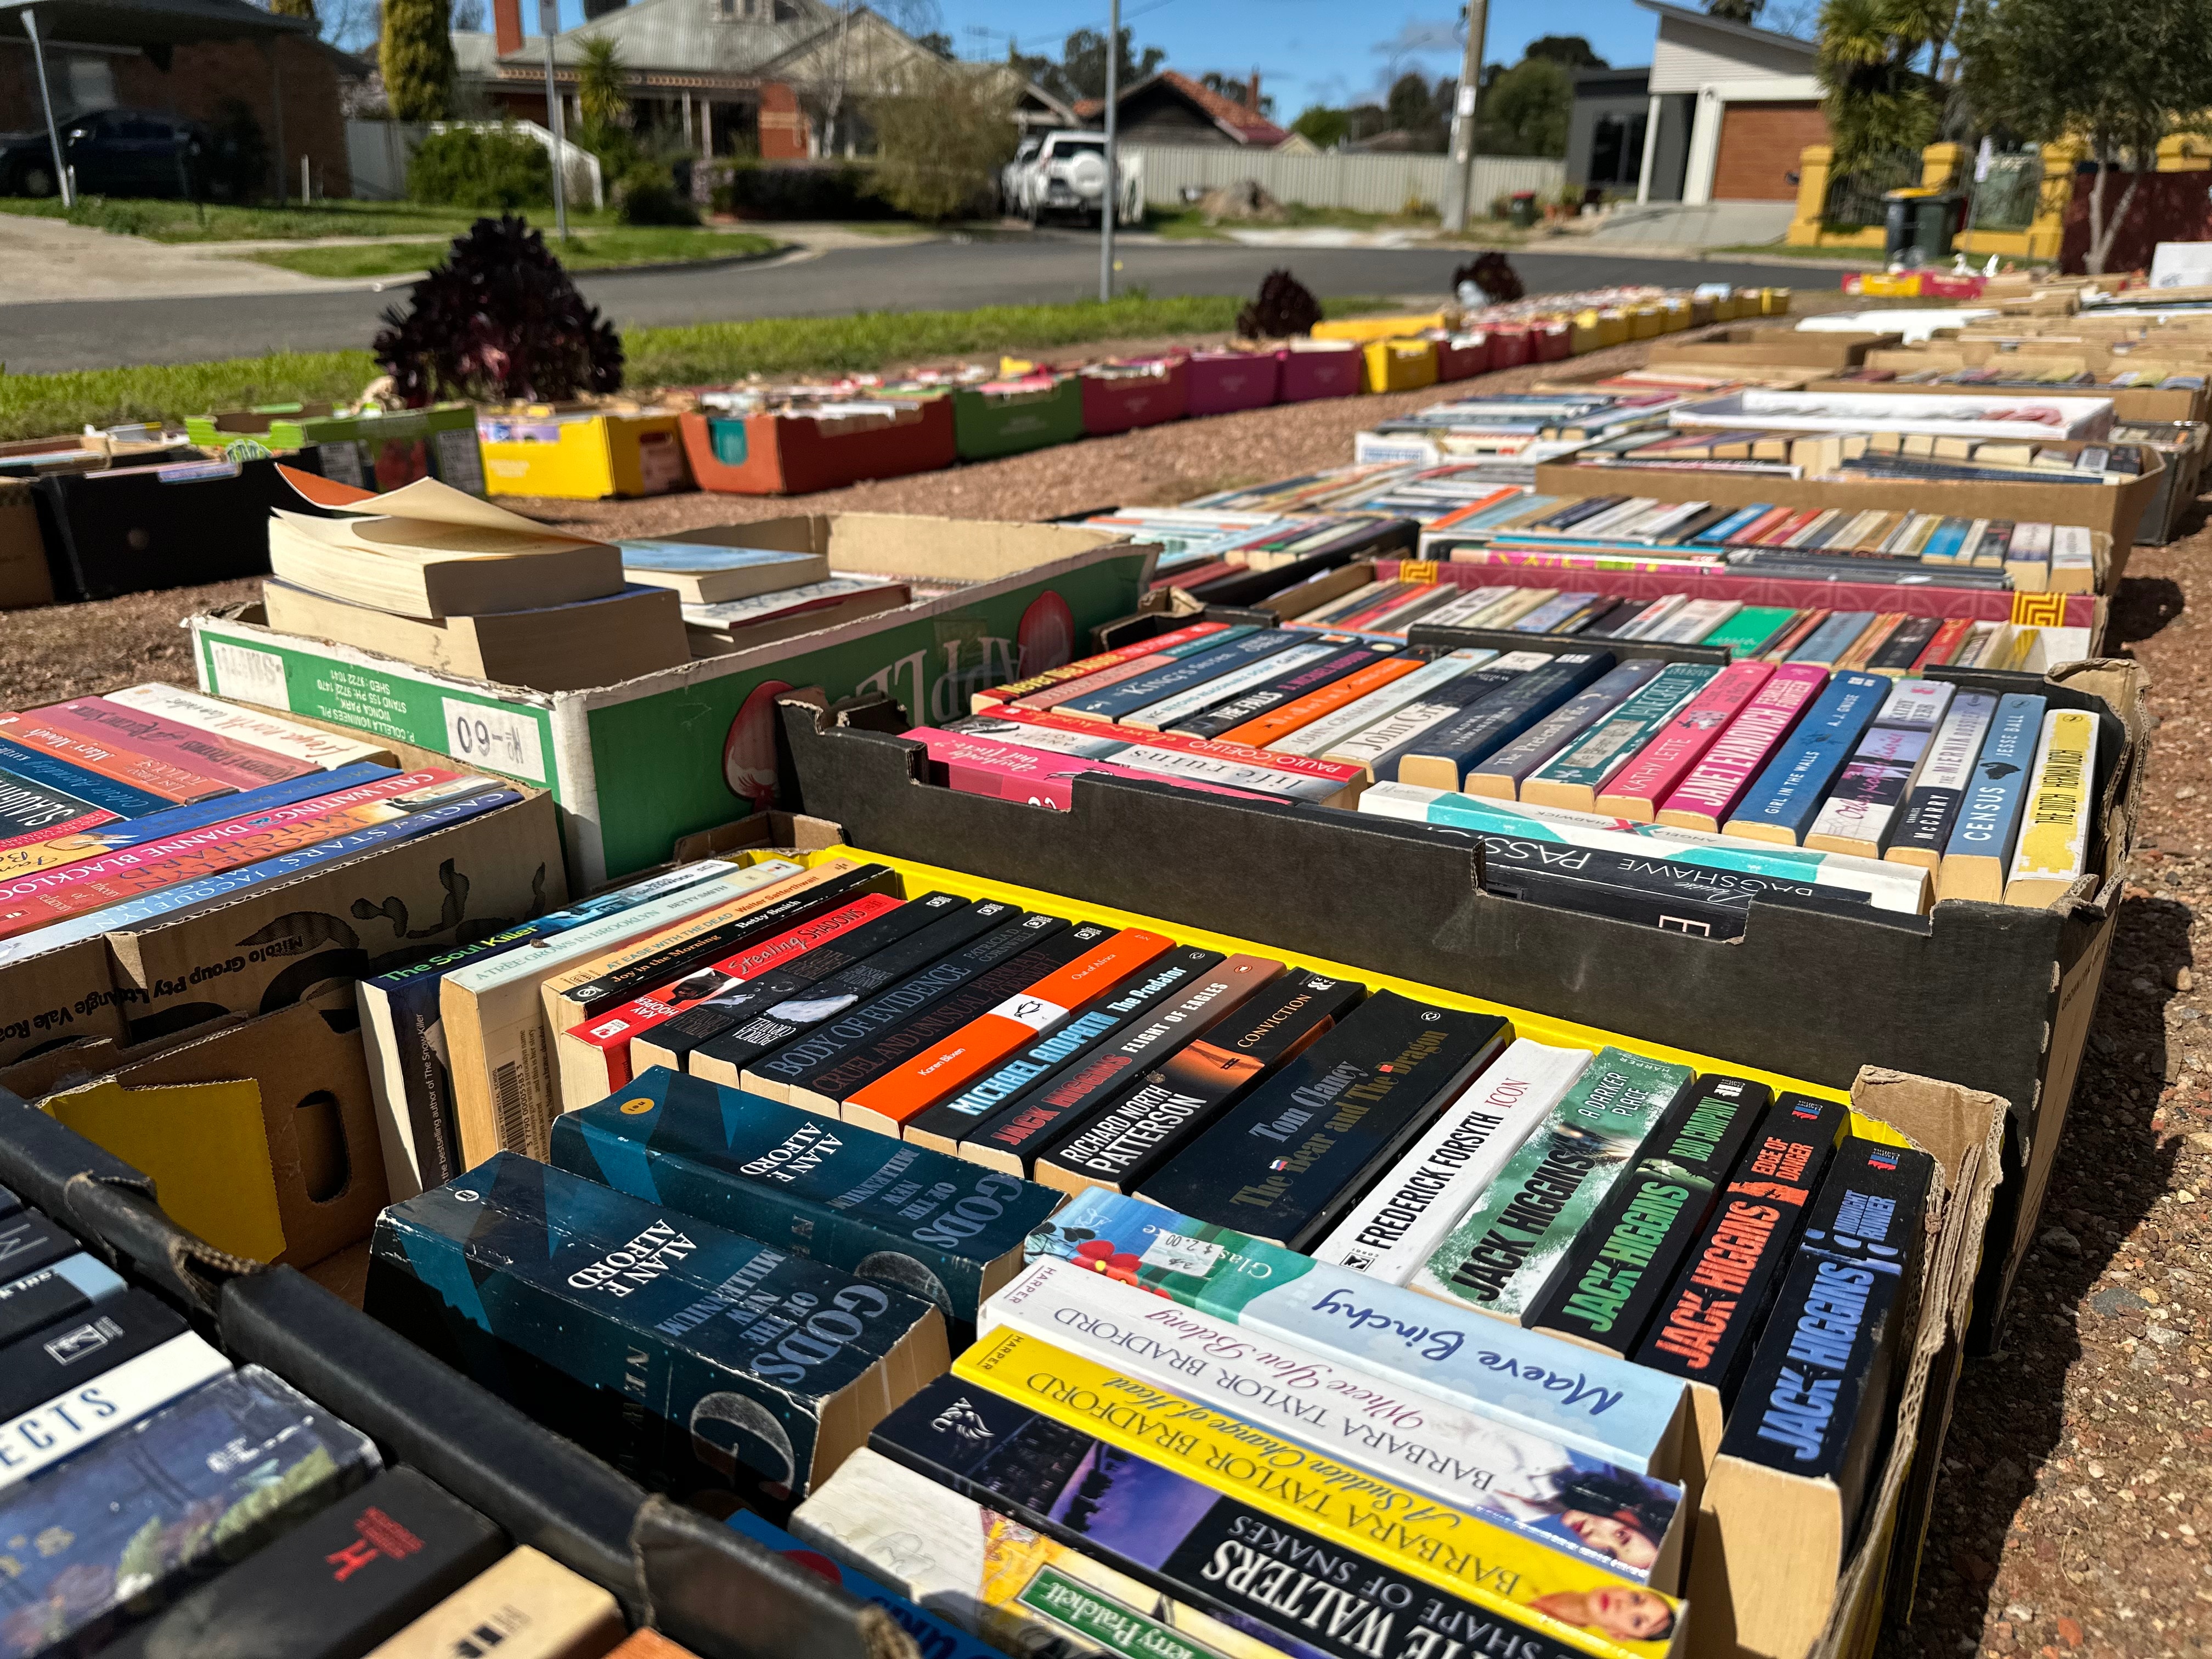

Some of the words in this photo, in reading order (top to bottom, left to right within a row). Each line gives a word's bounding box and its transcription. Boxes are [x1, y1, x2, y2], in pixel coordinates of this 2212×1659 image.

[317, 679, 334, 692] 1470
[335, 683, 352, 697] 9722
[369, 692, 381, 706] 155
[370, 680, 390, 695] SHED
[333, 708, 372, 729] NOMINEES
[340, 698, 362, 713] PARK
[363, 703, 391, 721] WONGA
[383, 696, 407, 713] STAND
[1208, 705, 1243, 720] THE
[1241, 690, 1284, 713] FALLS
[373, 720, 406, 740] COLELLA
[1344, 713, 1414, 752] John
[1704, 707, 1796, 768] EVANOVICH
[2003, 714, 2024, 733] BALL
[83, 742, 116, 761] Mary
[1189, 740, 1272, 760] COELHO
[1494, 751, 1522, 767] The
[1995, 731, 2019, 758] JESSE
[2045, 749, 2084, 769] KOCH
[1277, 755, 1342, 774] PAULO
[1619, 757, 1663, 792] KATHY
[1656, 737, 1692, 761] LETTE
[1794, 751, 1820, 774] WALLS
[2042, 765, 2081, 790] HERMAN
[376, 773, 436, 795] CALL
[1675, 765, 1747, 807] JANET
[1776, 786, 1795, 799] IN
[1783, 772, 1805, 788] THE
[1939, 775, 1957, 785] THE
[276, 786, 377, 821] WAITING
[414, 792, 504, 822] CAGE
[1764, 795, 1788, 815] GIRL
[1962, 785, 2007, 842] CENSUS
[2035, 811, 2074, 825] THE
[2039, 793, 2078, 815] DITCH
[392, 822, 409, 830] of
[1536, 810, 1616, 828] CHADWICK
[120, 811, 345, 879] MITCHARD
[140, 824, 250, 857] DIANNE
[279, 826, 388, 866] STARS
[1662, 828, 1717, 845] ANGELA
[135, 816, 374, 889] JACQUELYN
[36, 893, 75, 913] relativity
[71, 891, 94, 900] of
[89, 881, 123, 899] theory
[476, 973, 490, 981] A
[490, 958, 527, 975] TREE
[576, 933, 592, 944] IN
[589, 909, 661, 937] BROOKLYN
[667, 894, 701, 910] BETTY
[696, 884, 729, 901] SMITH
[606, 959, 622, 970] AT
[622, 946, 655, 964] EASE
[653, 933, 683, 951] WITH
[680, 924, 704, 939] THE
[700, 912, 733, 932] DEAD
[735, 896, 768, 913] Walter
[798, 909, 866, 941] SHADOWS
[249, 935, 303, 963] Mitolo
[379, 963, 433, 981] The
[428, 944, 487, 966] Soul
[480, 924, 540, 949] Killer
[611, 971, 633, 984] Joy
[633, 964, 646, 974] in
[647, 953, 670, 968] the
[670, 933, 723, 957] Morning
[734, 912, 769, 930] Betty
[766, 900, 801, 917] Smith
[190, 957, 245, 983] Group
[1071, 968, 1088, 981] Out
[1086, 963, 1098, 973] of
[1094, 952, 1118, 968] Africa
[1314, 977, 1337, 986] PAN
[153, 975, 187, 998] Pty
[33, 1007, 74, 1030] Vale
[630, 1006, 662, 1019] KAY
[634, 996, 680, 1017] HOOPER
[764, 1034, 826, 1077] BODY
[867, 964, 972, 1023] EVIDENCE
[1237, 993, 1313, 1048] CONVICTION
[415, 1013, 425, 1037] Killer
[731, 1026, 774, 1046] PATRICIA
[754, 1017, 797, 1038] CORNWELL
[421, 1036, 431, 1062] Snow
[947, 1059, 1048, 1116] MICHAEL
[1028, 1011, 1121, 1064] RIDPATH
[1107, 992, 1141, 1014] The
[1135, 965, 1188, 1000] Predator
[425, 1058, 435, 1079] The
[917, 1057, 944, 1076] Karen
[939, 1046, 966, 1063] Blixen
[990, 1105, 1062, 1146] JACK
[1041, 1053, 1133, 1109] HIGGINS
[1120, 1022, 1172, 1054] FLIGHT
[1164, 1009, 1186, 1024] OF
[1180, 981, 1229, 1013] EAGLES
[1620, 1057, 1671, 1074] HARPER
[429, 1086, 442, 1118] author
[495, 1092, 504, 1124] TECHNICAL
[517, 1073, 528, 1115] 00005583
[1248, 1107, 1315, 1143] Tom
[1290, 1060, 1370, 1108] Clancy
[1577, 1106, 1599, 1120] A
[1589, 1071, 1630, 1108] DARKER
[1614, 1087, 1650, 1117] PLACE
[523, 1117, 532, 1138] 7790
[1060, 1111, 1130, 1165] RICHARD
[1115, 1083, 1173, 1122] NORTH
[1085, 1093, 1208, 1175] PATTERSON
[1228, 1175, 1294, 1209] The
[1324, 1101, 1372, 1133] and
[1374, 1029, 1450, 1076] Dragon
[433, 1115, 448, 1167] bestselling
[739, 1121, 822, 1176] ALFORD
[786, 1132, 843, 1175] ALAN
[1765, 1136, 1791, 1152] OF
[441, 1167, 450, 1181] the
[1355, 1165, 1457, 1250] FREDERICK
[1426, 1110, 1505, 1169] FORSYTH
[1483, 1077, 1532, 1109] ICON
[927, 1181, 958, 1200] OF
[897, 1198, 936, 1221] THE
[912, 1173, 1023, 1249] GODS
[1599, 1181, 1690, 1268] HIGGINS
[1449, 1228, 1537, 1302] JACK
[1496, 1148, 1596, 1237] HIGGINS
[567, 1218, 677, 1290] ALFORD
[1166, 1232, 1197, 1251] 2.00
[1351, 1247, 1380, 1258] CORGI
[1690, 1200, 1781, 1295] HIGGINS
[623, 1232, 697, 1285] ALAN
[1561, 1259, 1643, 1333] JACK
[1311, 1288, 1465, 1361] Binchy
[1654, 1288, 1738, 1370] JACK
[1786, 1260, 1875, 1372] HIGGINS
[751, 1284, 889, 1384] GODS
[1054, 1307, 1209, 1377] BRADFORD
[1477, 1348, 1625, 1415] Maeve
[1164, 1400, 1207, 1423] of
[1216, 1369, 1329, 1428] TAYLOR
[1757, 1365, 1842, 1462] JACK
[1027, 1372, 1199, 1457] BRADFORD
[1342, 1417, 1497, 1492] BARBARA
[1206, 1445, 1335, 1520] TAYLOR
[1228, 1515, 1357, 1583] SNAKES
[1346, 1504, 1521, 1597] BARBARA
[1202, 1539, 1403, 1659] WALTERS
[1360, 1578, 1414, 1611] OF
